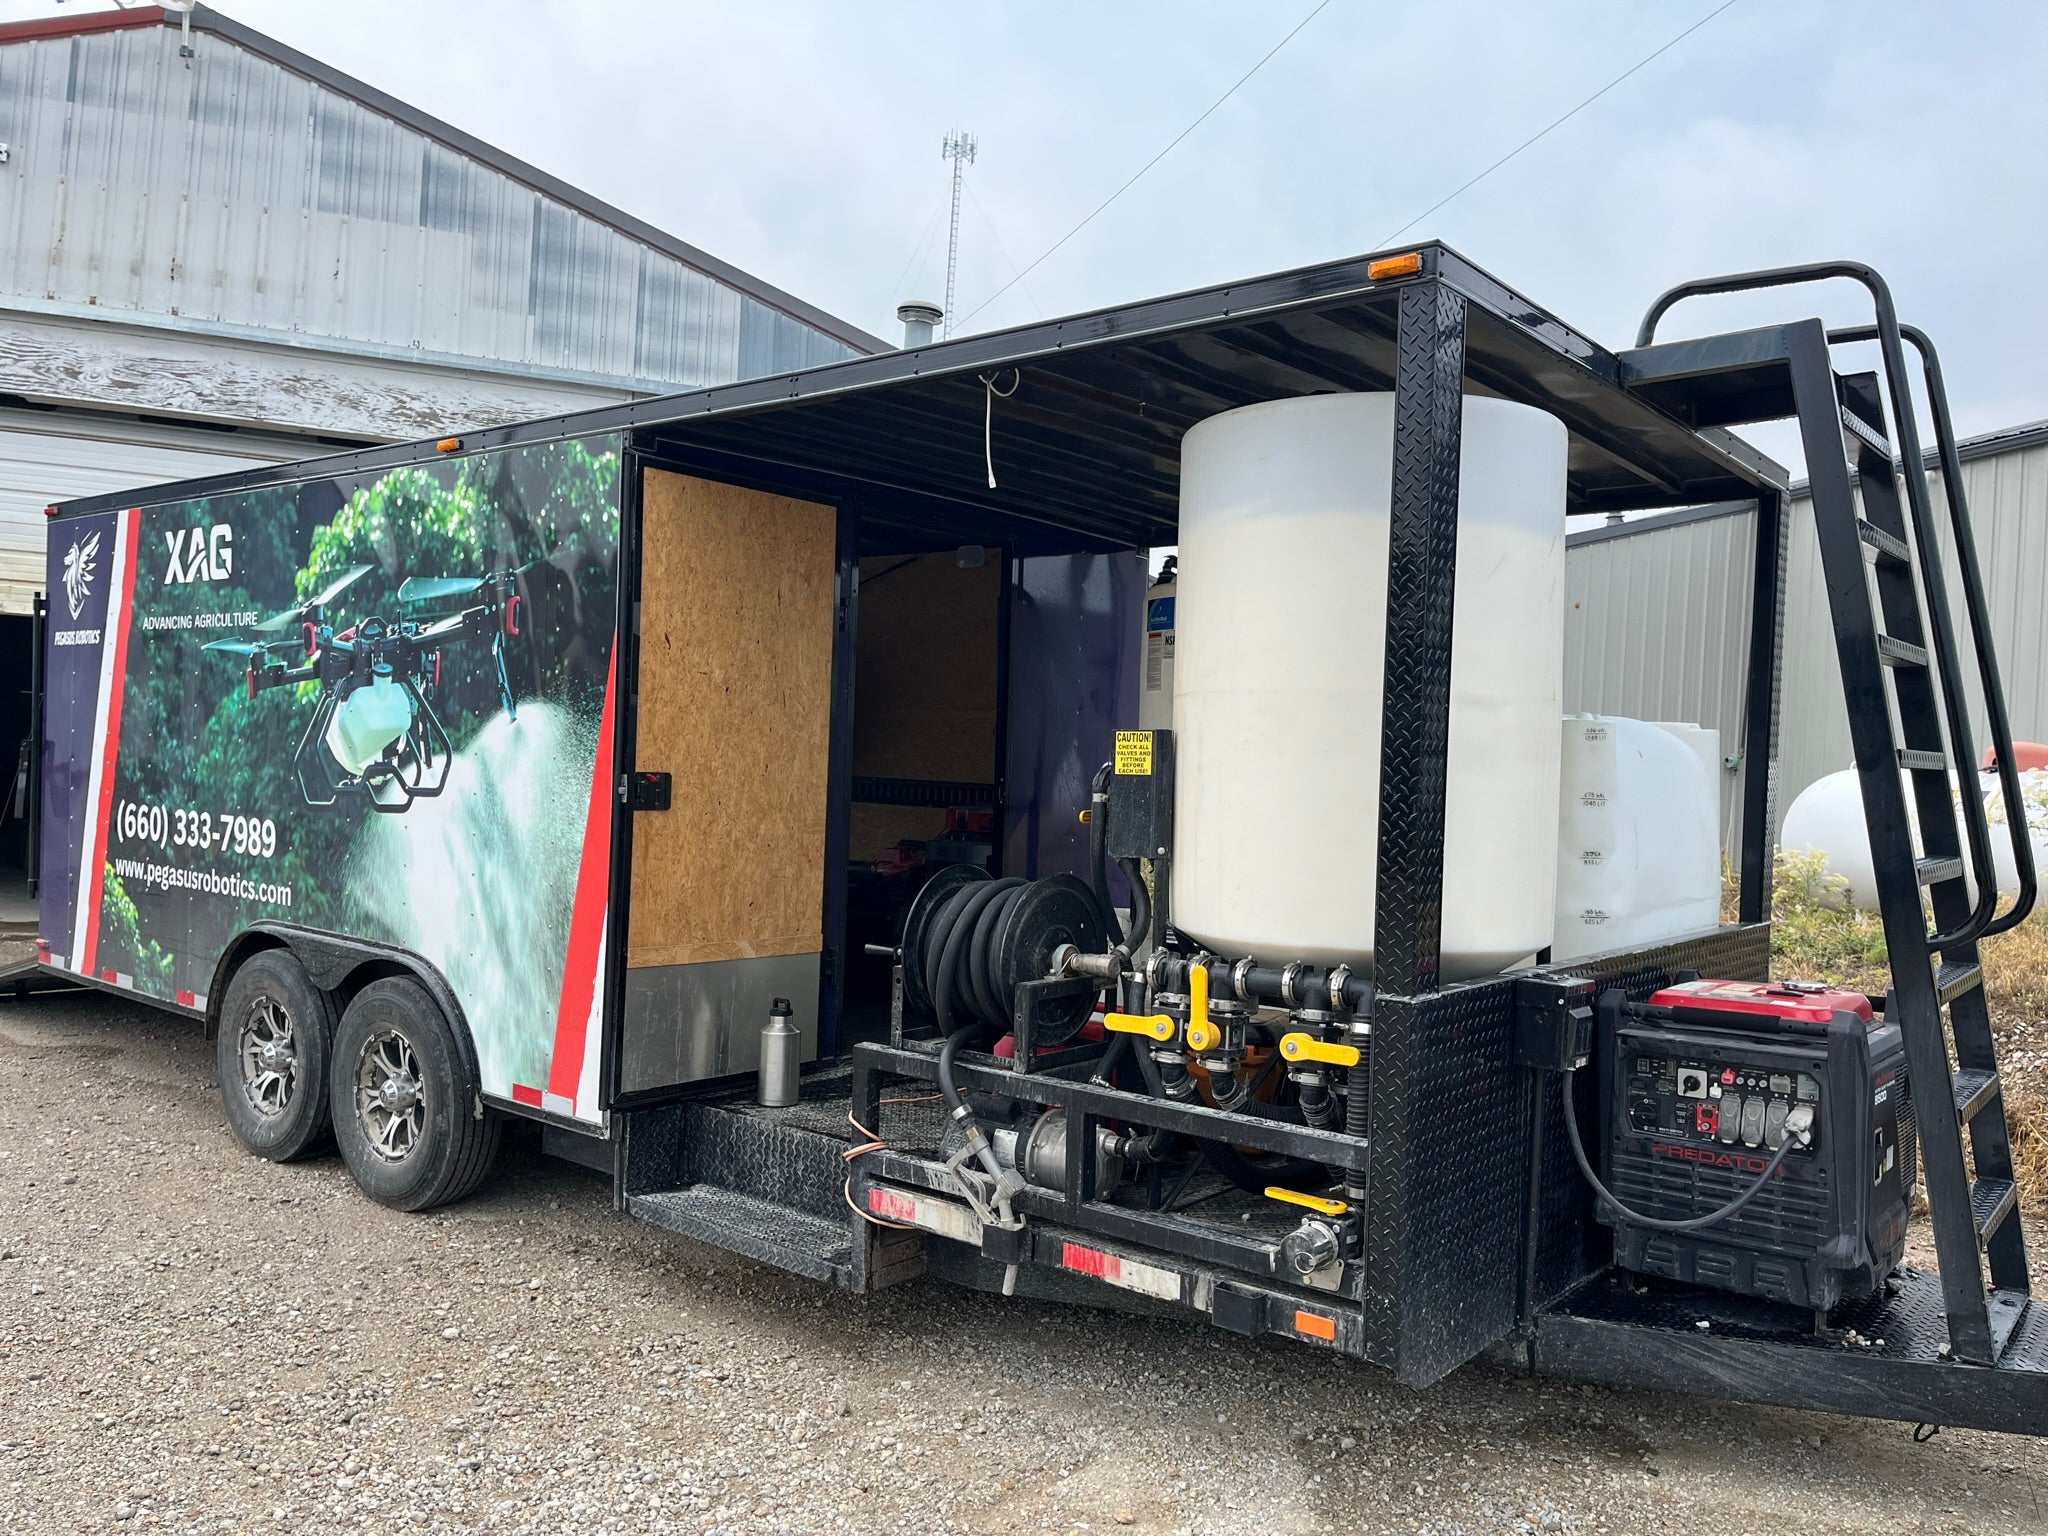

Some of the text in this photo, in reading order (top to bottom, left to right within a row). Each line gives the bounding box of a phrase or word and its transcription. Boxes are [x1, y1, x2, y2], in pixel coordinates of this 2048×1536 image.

[164, 523, 232, 585] XAG
[142, 611, 258, 631] ADVANCING AGRICULTURE
[116, 799, 277, 859] (660) 333-7989
[115, 858, 292, 907] www.pegasusrobotics.com
